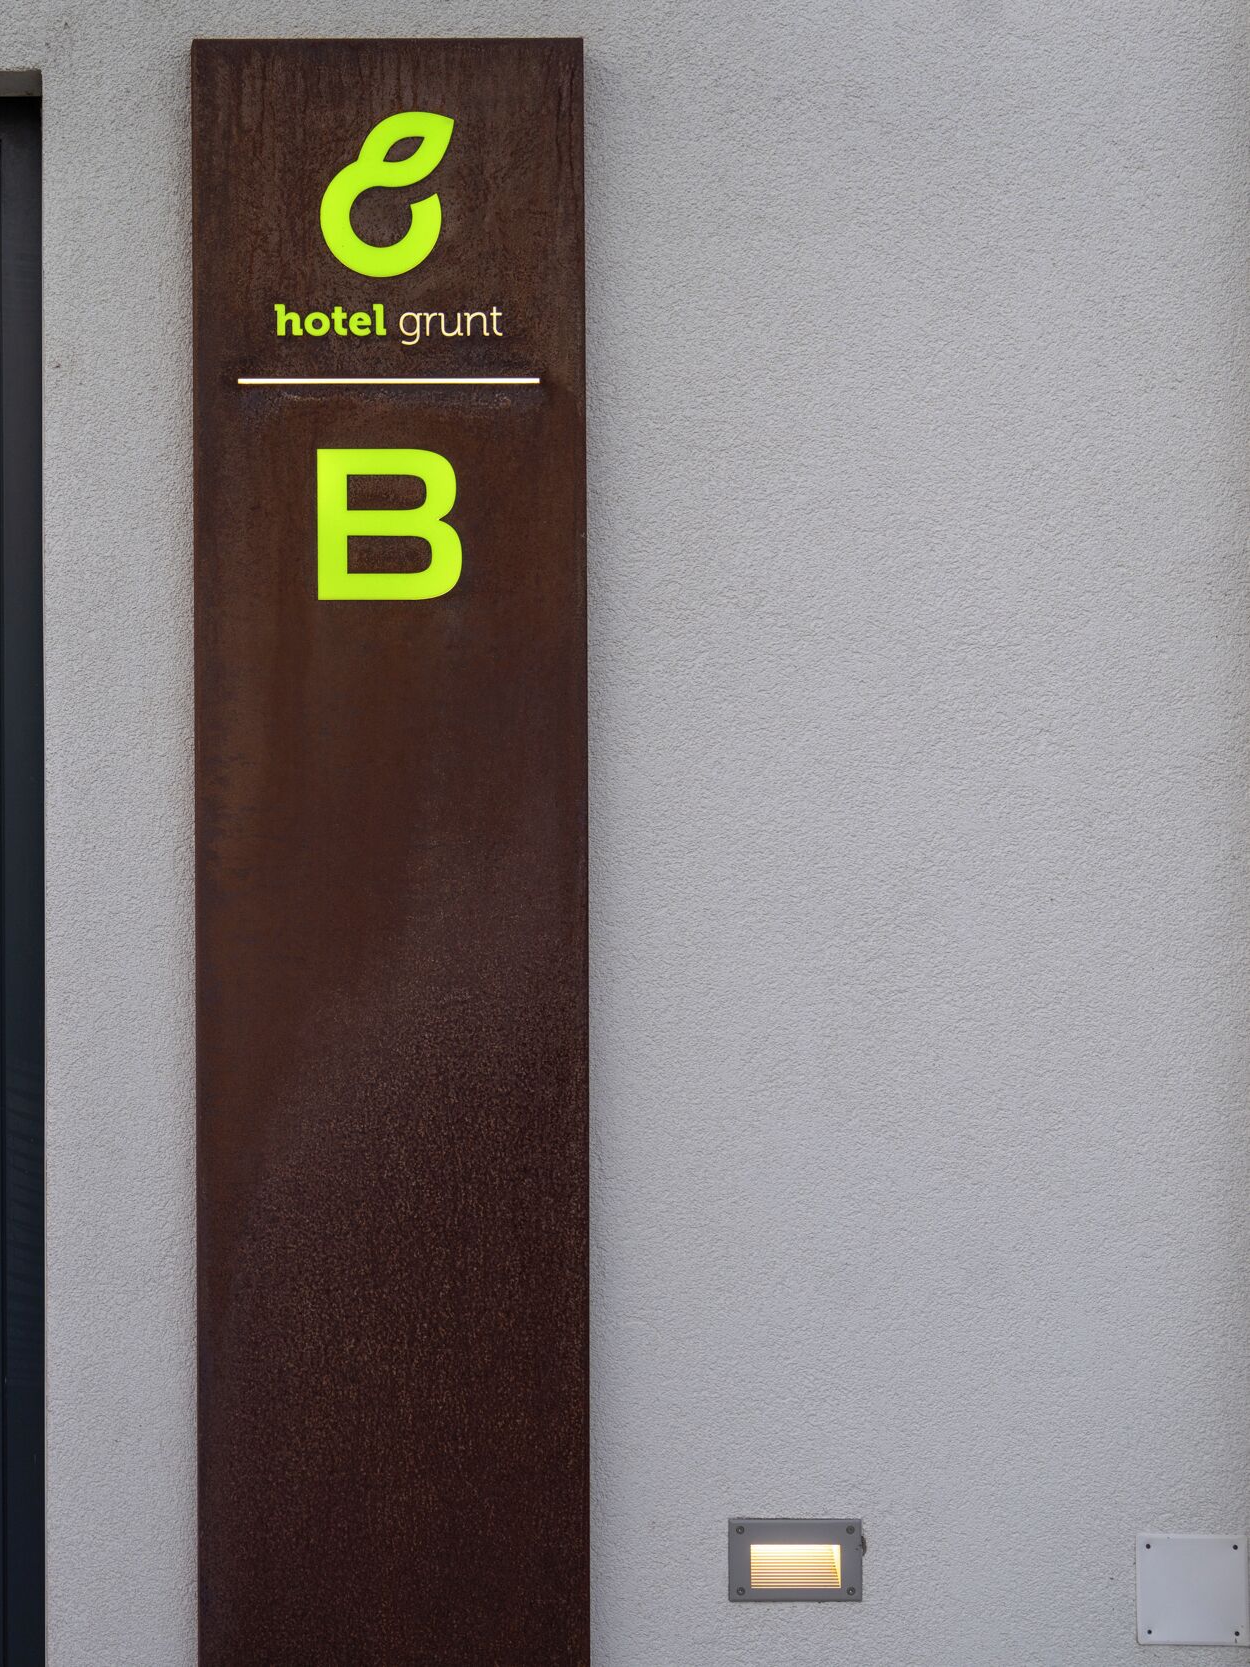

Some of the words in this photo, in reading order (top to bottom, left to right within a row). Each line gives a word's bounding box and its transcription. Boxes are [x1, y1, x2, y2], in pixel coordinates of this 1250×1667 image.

[275, 303, 387, 337] hotel
[399, 306, 503, 346] grunt
[316, 448, 463, 601] B
